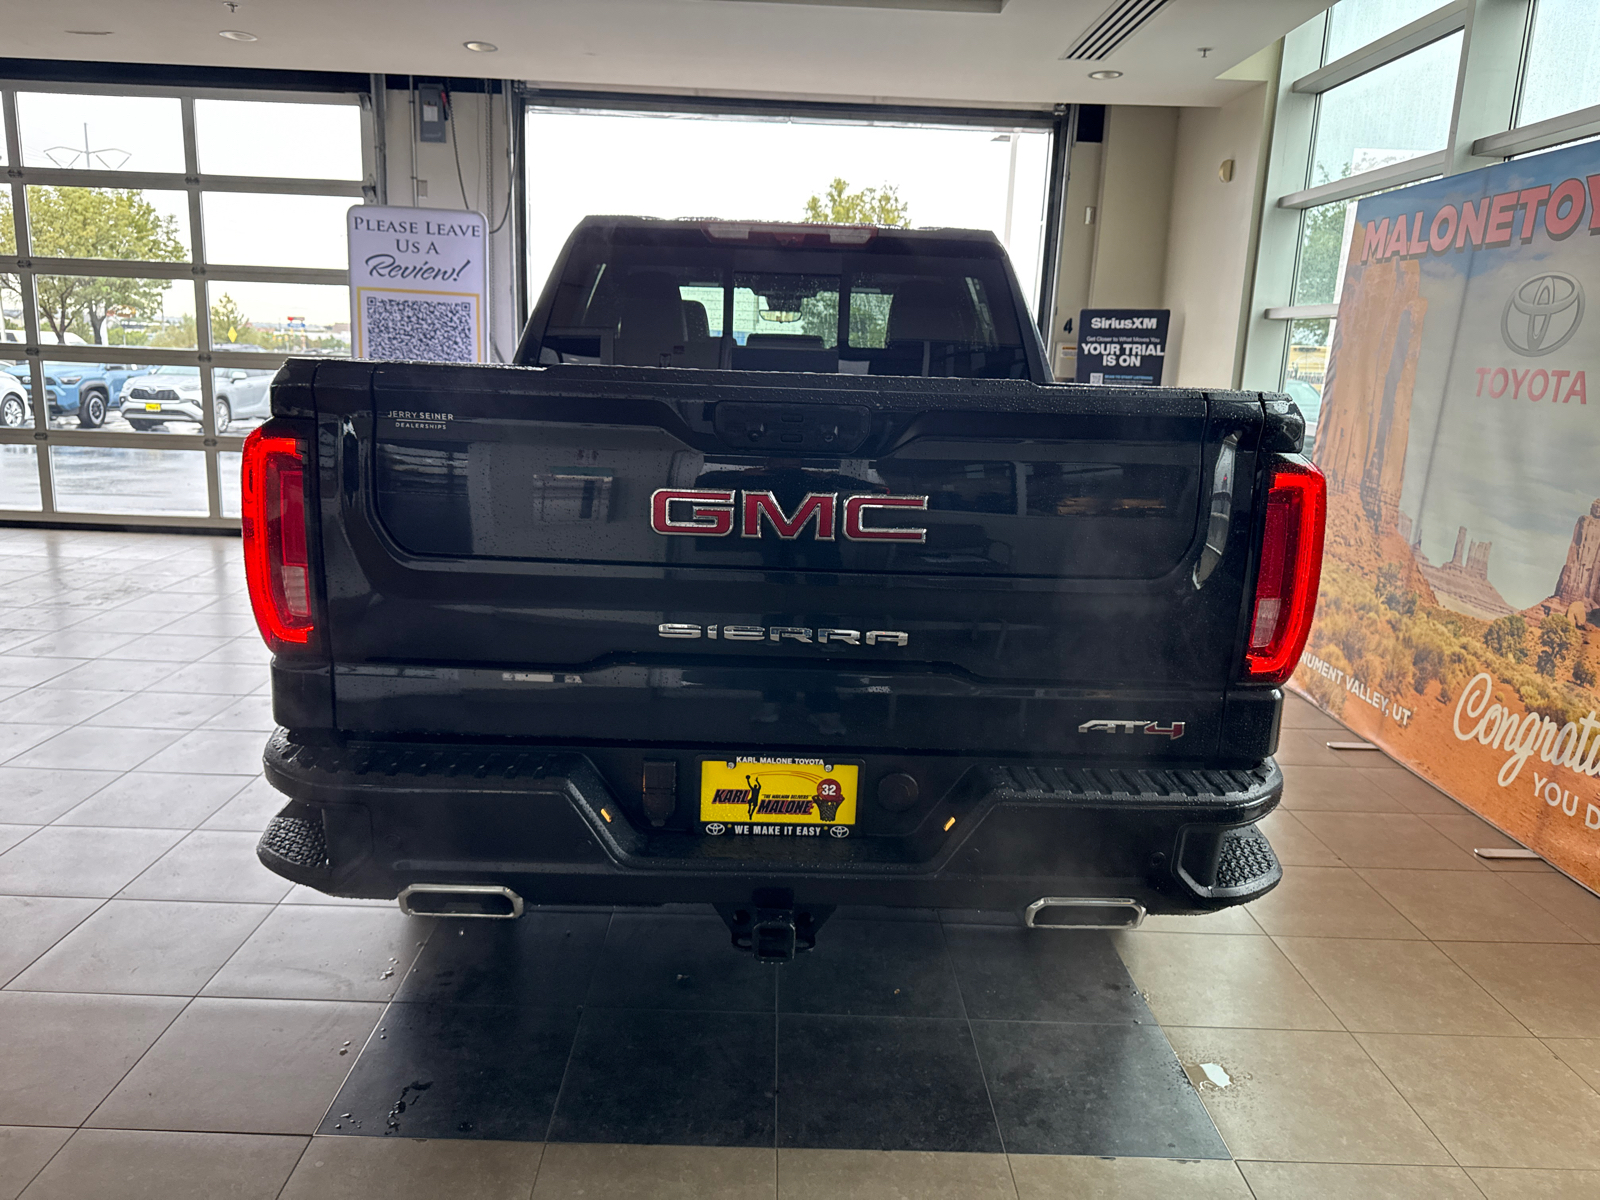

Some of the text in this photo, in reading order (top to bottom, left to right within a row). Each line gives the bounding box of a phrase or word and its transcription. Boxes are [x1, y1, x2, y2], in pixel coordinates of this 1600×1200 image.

[354, 216, 481, 238] PLEASE LEAVE
[395, 238, 440, 255] US A
[364, 253, 471, 282] Review!
[1063, 317, 1073, 334] 4
[1090, 317, 1157, 329] SiriusXM
[1081, 343, 1120, 355] YOUR
[1122, 343, 1165, 356] TRIAL
[1102, 355, 1141, 367] IS ON
[1475, 367, 1587, 405] TOYOTA
[387, 410, 454, 420] JERRY SEINER
[395, 422, 447, 430] DEALERSHIPS
[650, 488, 929, 544] GMC
[658, 623, 909, 647] SIERRA
[1345, 674, 1390, 717] VALLEY,
[1392, 703, 1411, 725] UT
[1078, 719, 1186, 740] AT4
[736, 756, 824, 766] KARL MALONE TOYOTA
[711, 789, 751, 804] KARL
[821, 784, 837, 796] 32
[1533, 772, 1579, 817] YOU
[756, 799, 814, 815] MALONE
[734, 825, 821, 836] WE MAKE IT EASY
